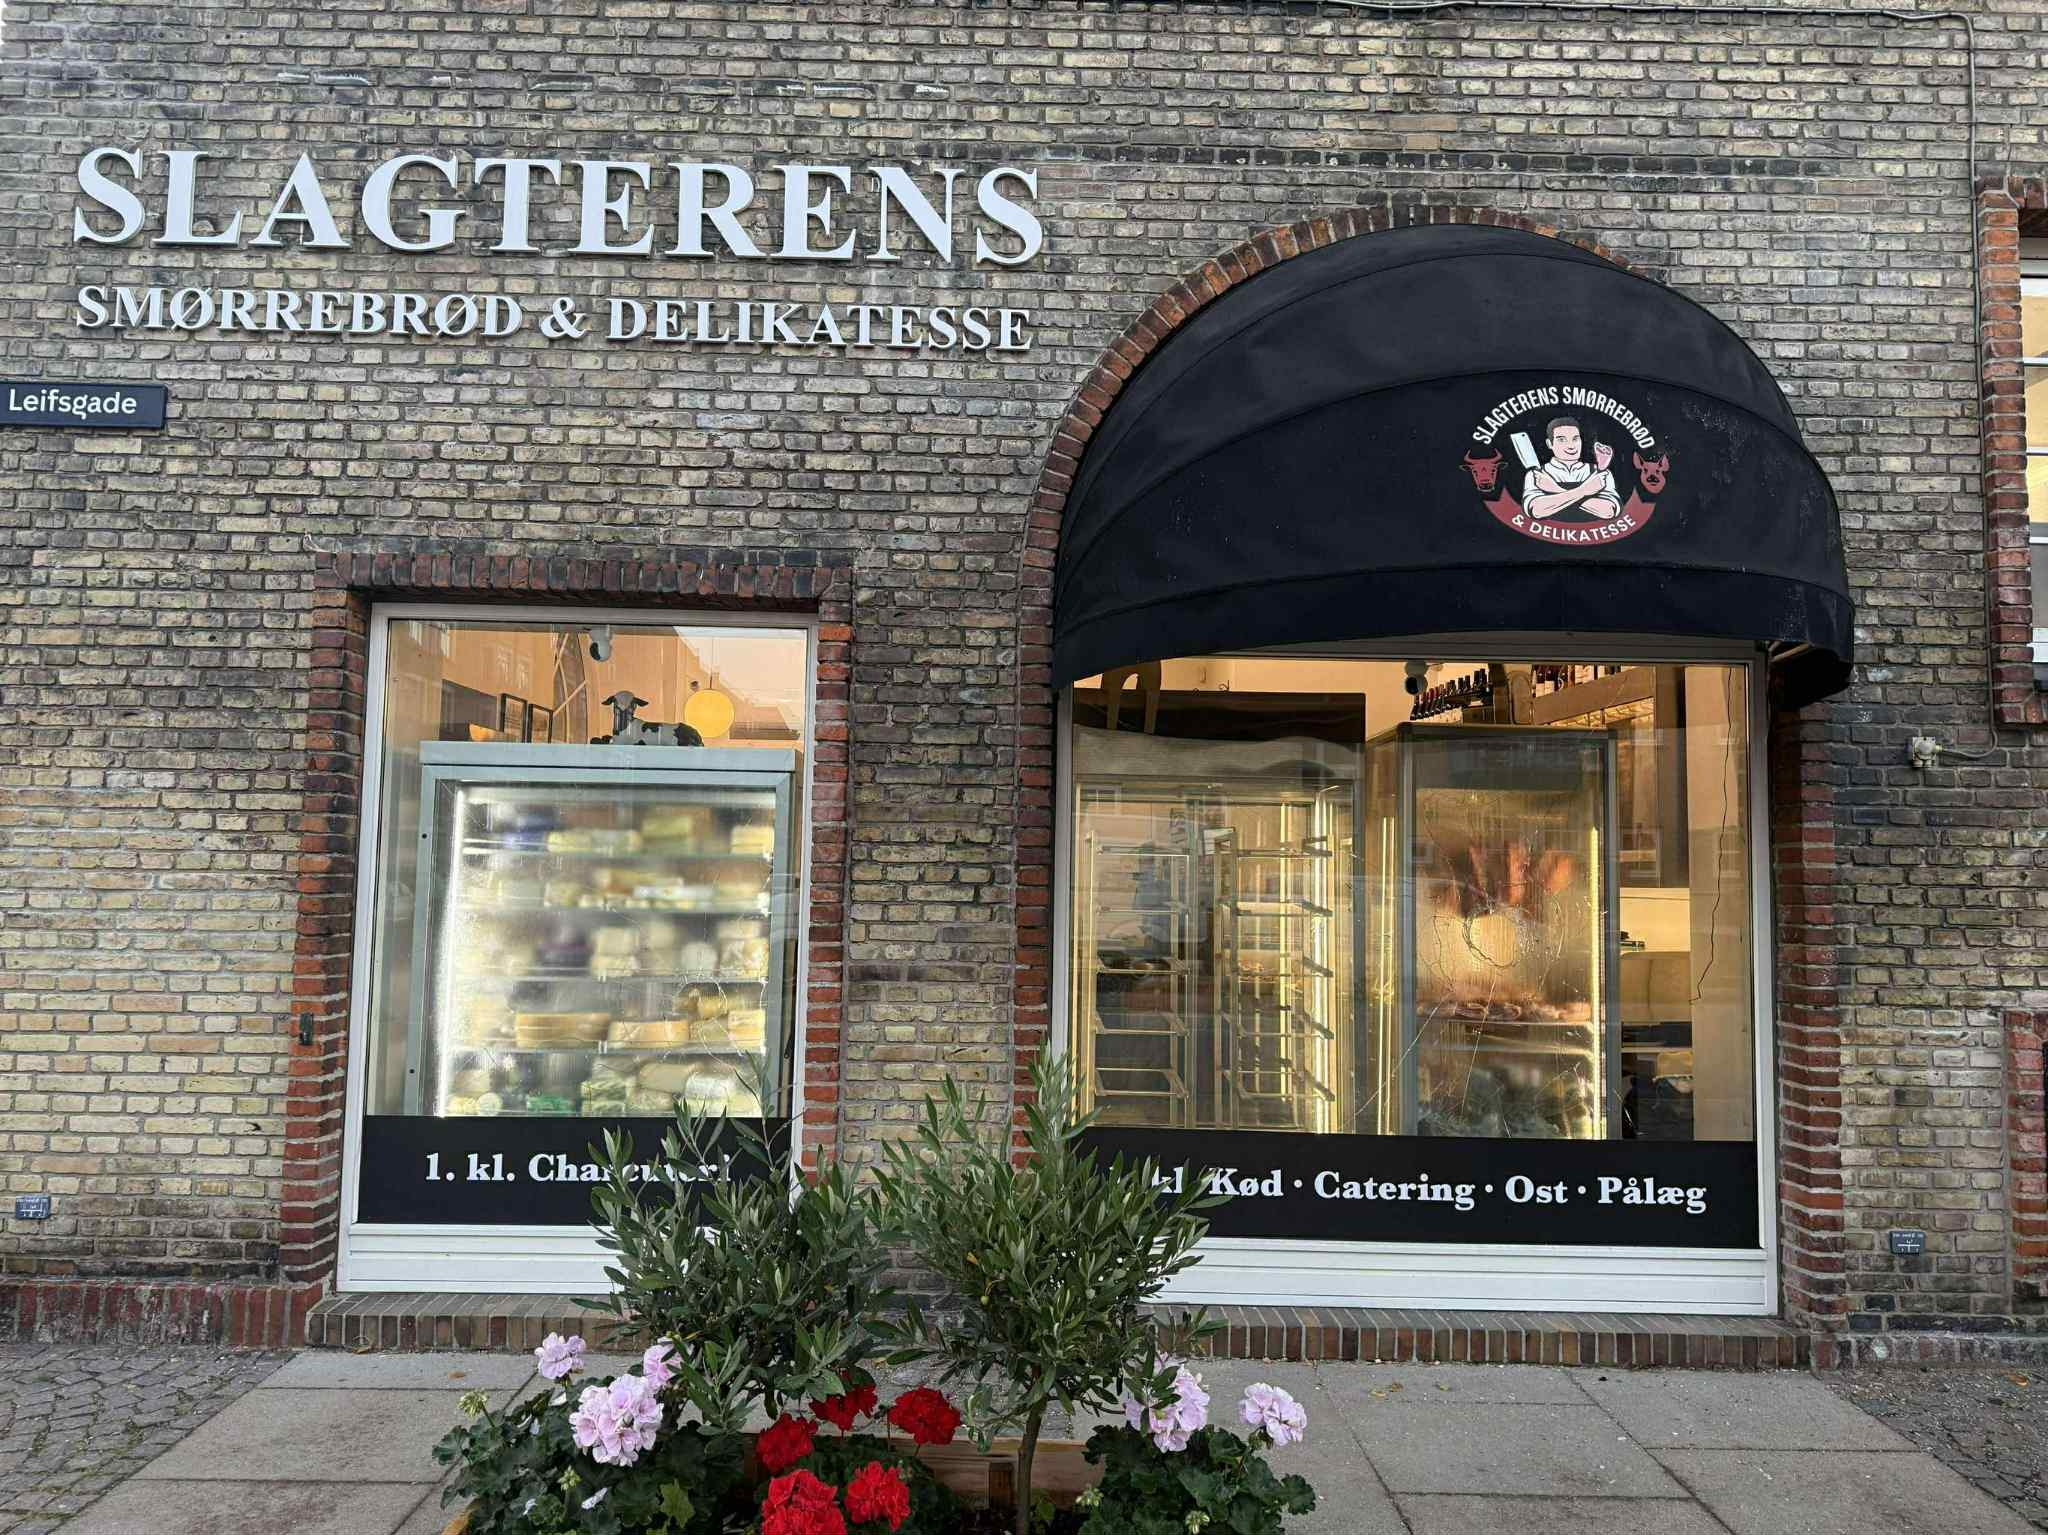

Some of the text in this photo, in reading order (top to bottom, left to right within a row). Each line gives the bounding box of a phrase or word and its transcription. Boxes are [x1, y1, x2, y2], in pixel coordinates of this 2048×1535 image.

[74, 147, 1044, 264] SLAGTERENS
[77, 285, 1032, 351] SMØRREBRØD & DELIKATESSE
[9, 388, 137, 420] Leifsgade
[1472, 386, 1655, 449] SLAGTERENS SMØRREBRØD
[1511, 514, 1636, 542] & DELIKATESSE
[426, 1153, 455, 1181] 1.
[467, 1154, 515, 1182] kl.
[1207, 1167, 1284, 1197] Kød
[1314, 1170, 1476, 1211] Catering
[1505, 1175, 1569, 1204] Ost
[1597, 1176, 1707, 1214] Pålæg
